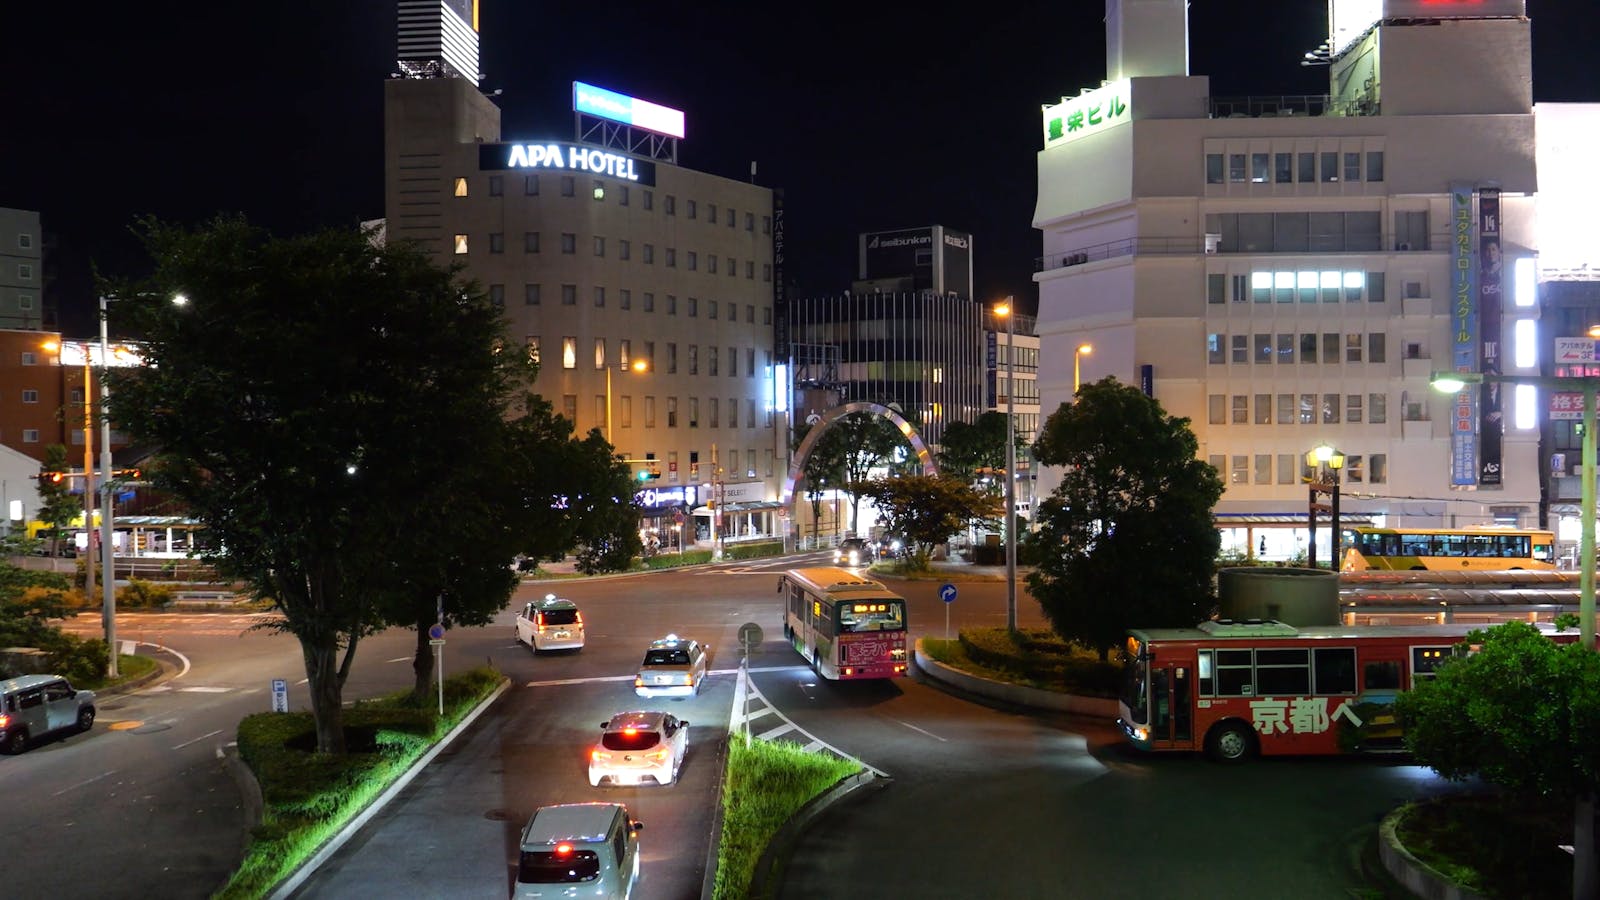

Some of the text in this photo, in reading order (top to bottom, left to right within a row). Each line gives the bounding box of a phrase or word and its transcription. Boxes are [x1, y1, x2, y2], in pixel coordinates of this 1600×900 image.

[1048, 95, 1126, 141] 豊栄ビル
[507, 144, 639, 180] APA HOTEL
[1250, 696, 1363, 735] 京都へ
